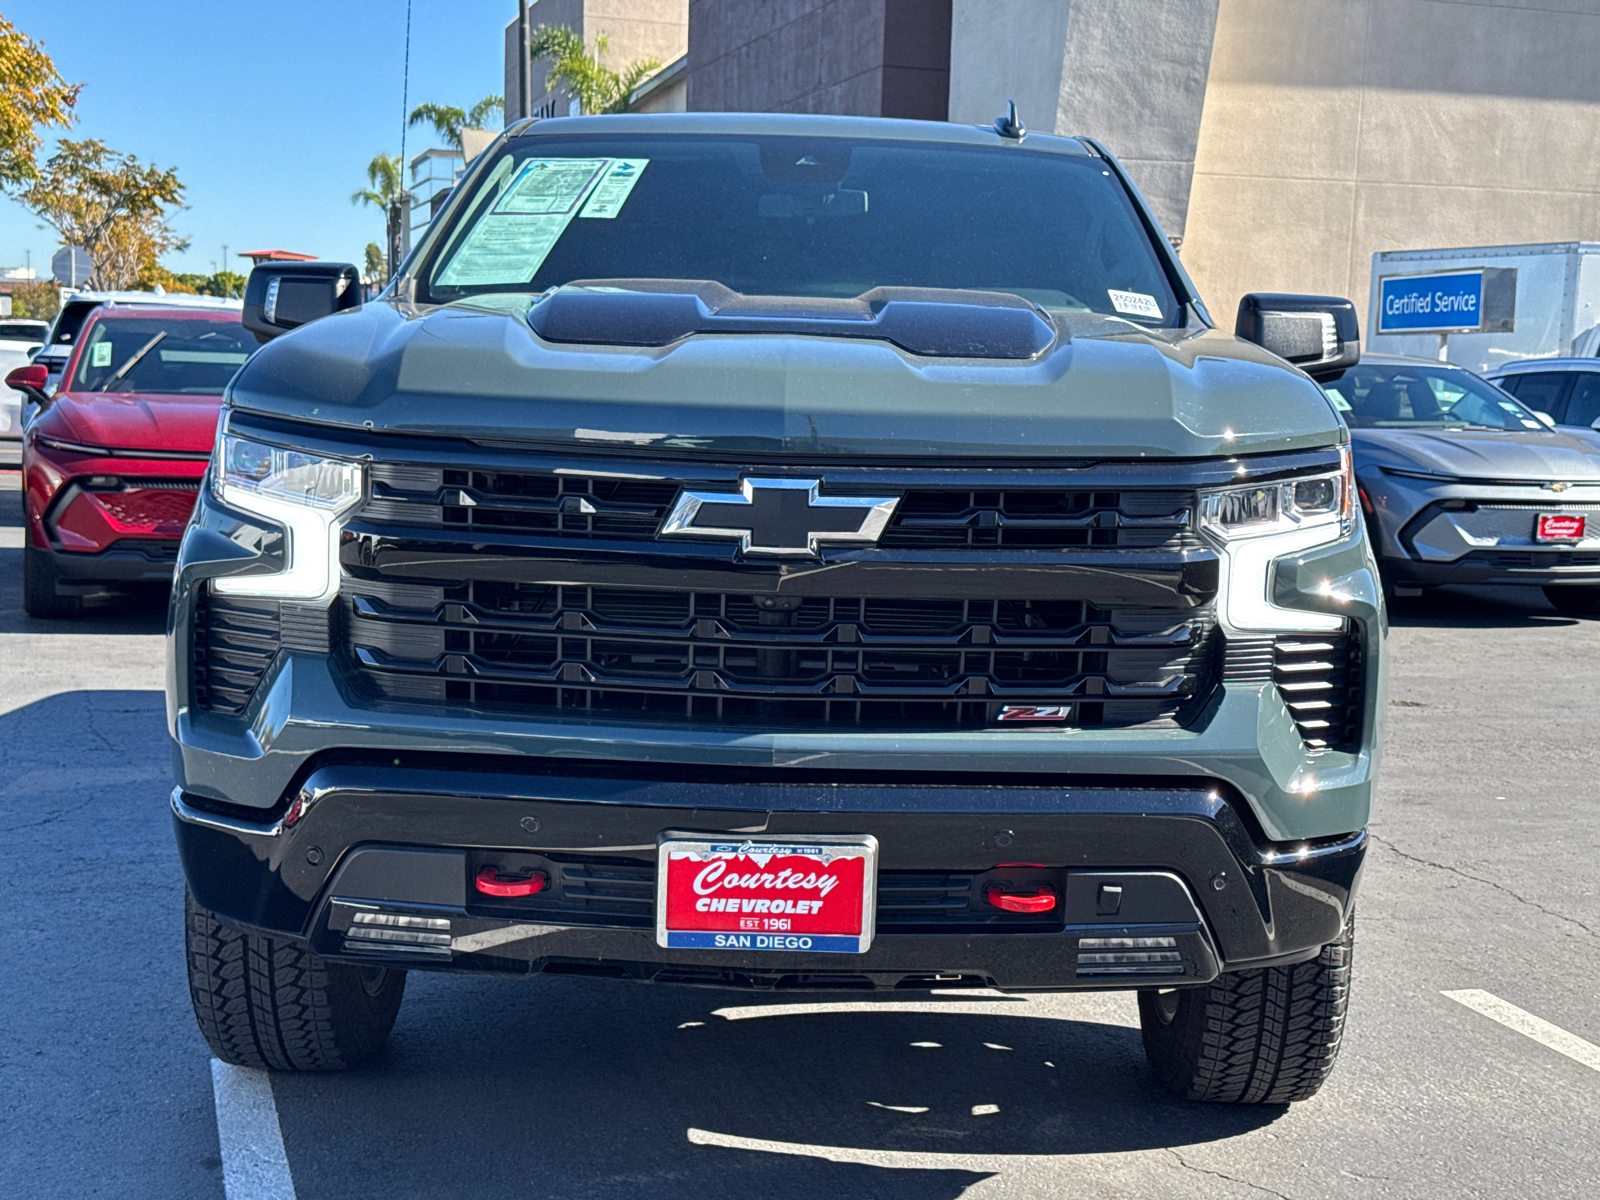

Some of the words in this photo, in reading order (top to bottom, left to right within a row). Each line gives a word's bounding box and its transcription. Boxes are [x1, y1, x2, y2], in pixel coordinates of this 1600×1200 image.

[1386, 292, 1431, 315] Certified
[1434, 290, 1476, 312] Service
[1544, 518, 1580, 529] Courtesy
[997, 705, 1071, 720] Z71
[738, 840, 792, 855] Courtesy
[693, 861, 839, 898] Courtesy
[696, 898, 823, 914] CHEVROLET
[763, 918, 791, 930] 1961
[714, 935, 751, 947] SAN
[756, 936, 812, 949] DIEGO
